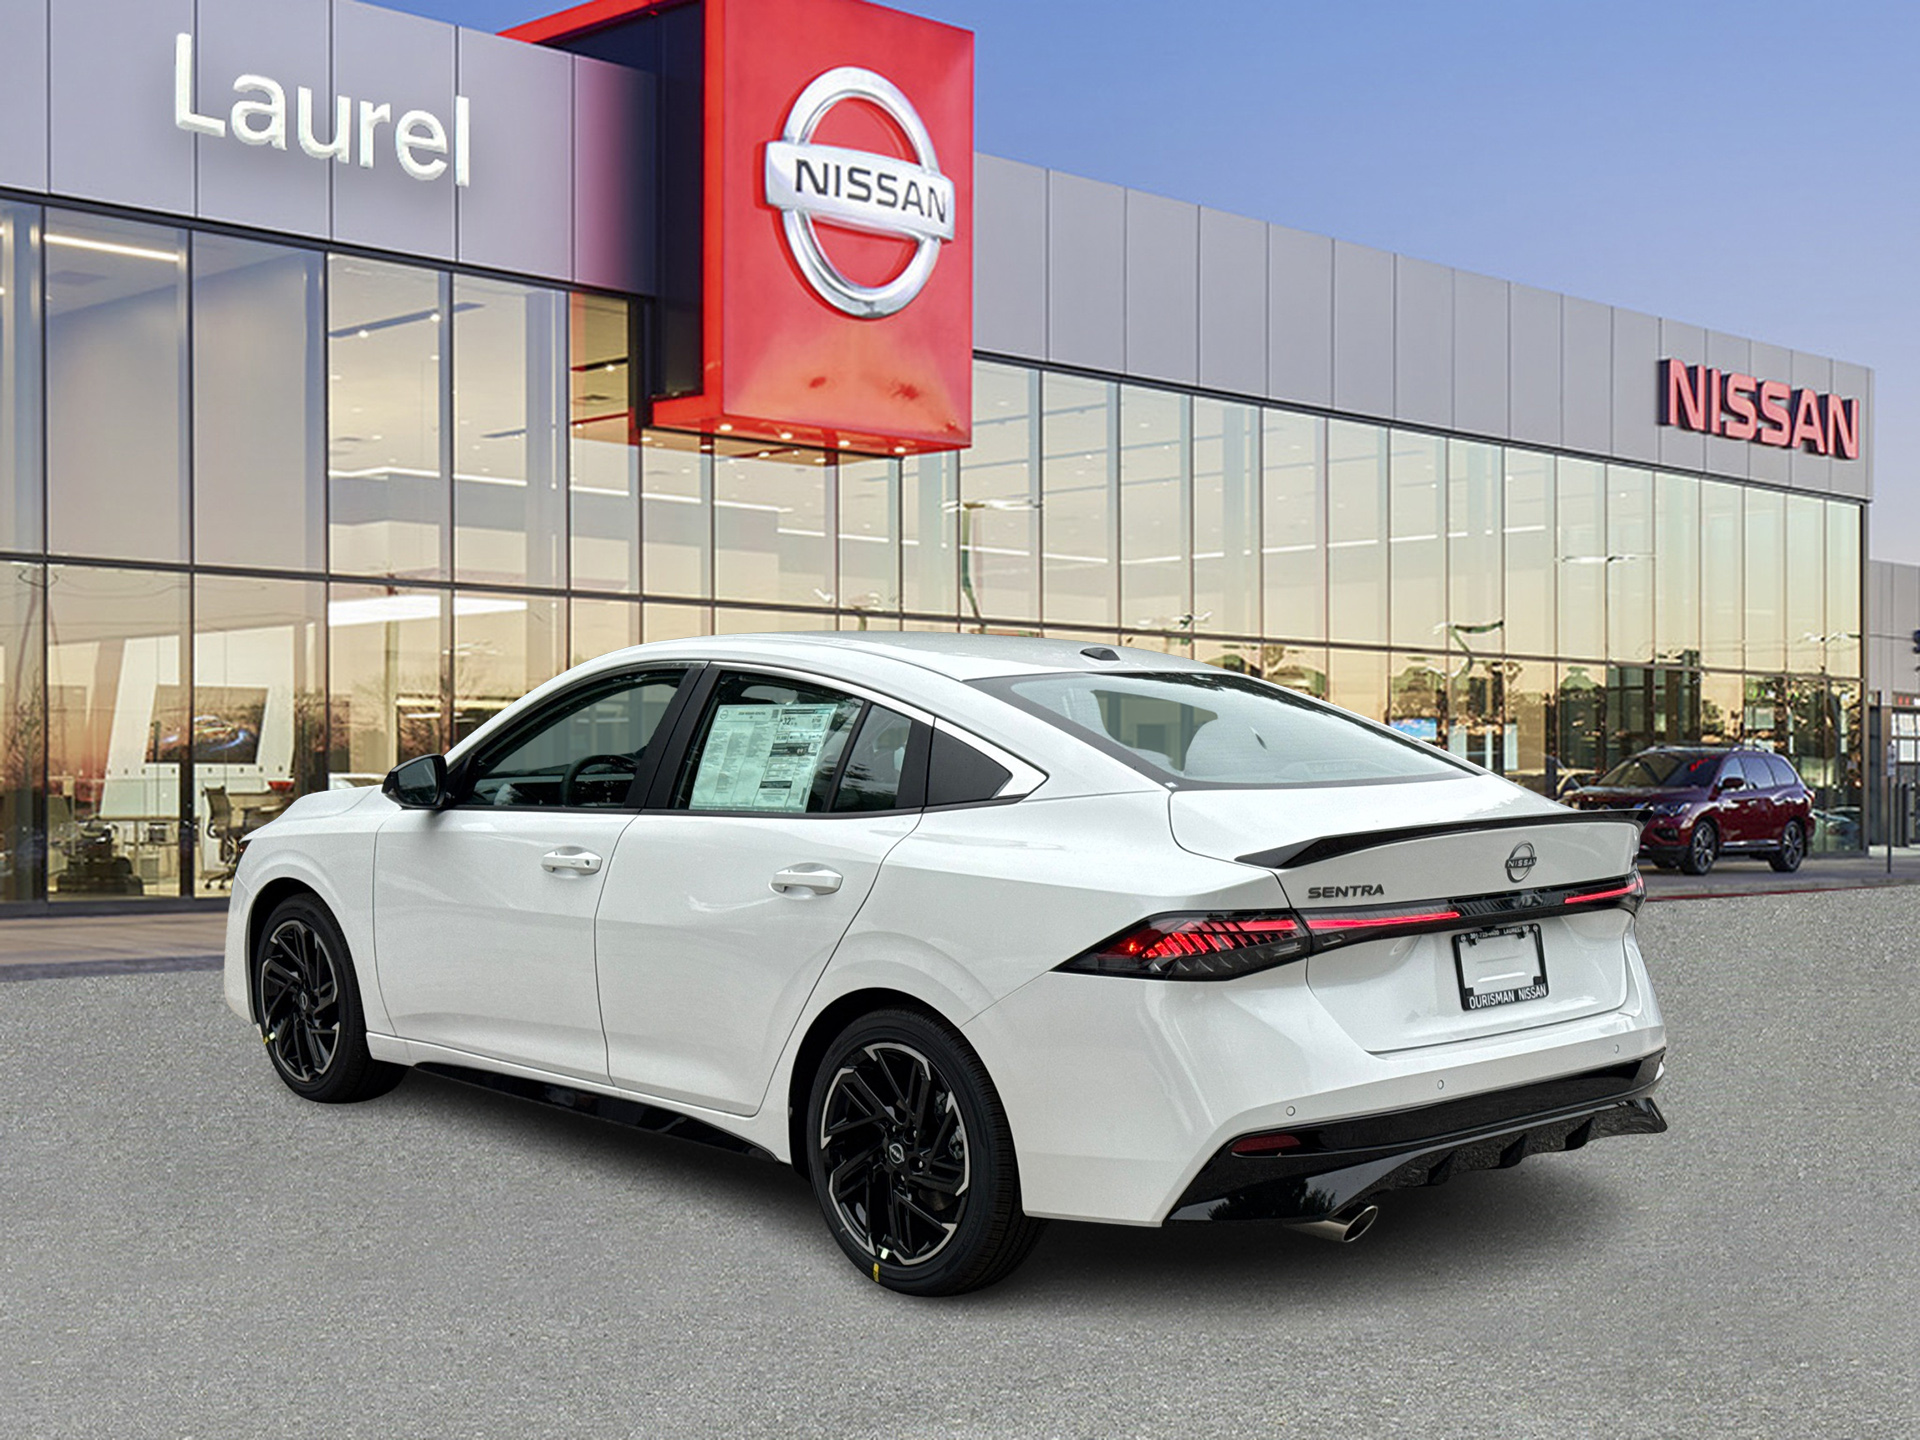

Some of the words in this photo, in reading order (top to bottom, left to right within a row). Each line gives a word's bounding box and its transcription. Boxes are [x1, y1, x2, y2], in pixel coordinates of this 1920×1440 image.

[175, 33, 469, 187] Laurel
[795, 158, 946, 223] NISSAN
[1665, 358, 1859, 459] NISSAN
[1308, 884, 1385, 899] SENTRA
[1469, 990, 1515, 1009] OURISMAN
[1518, 984, 1547, 1001] NISSAN
